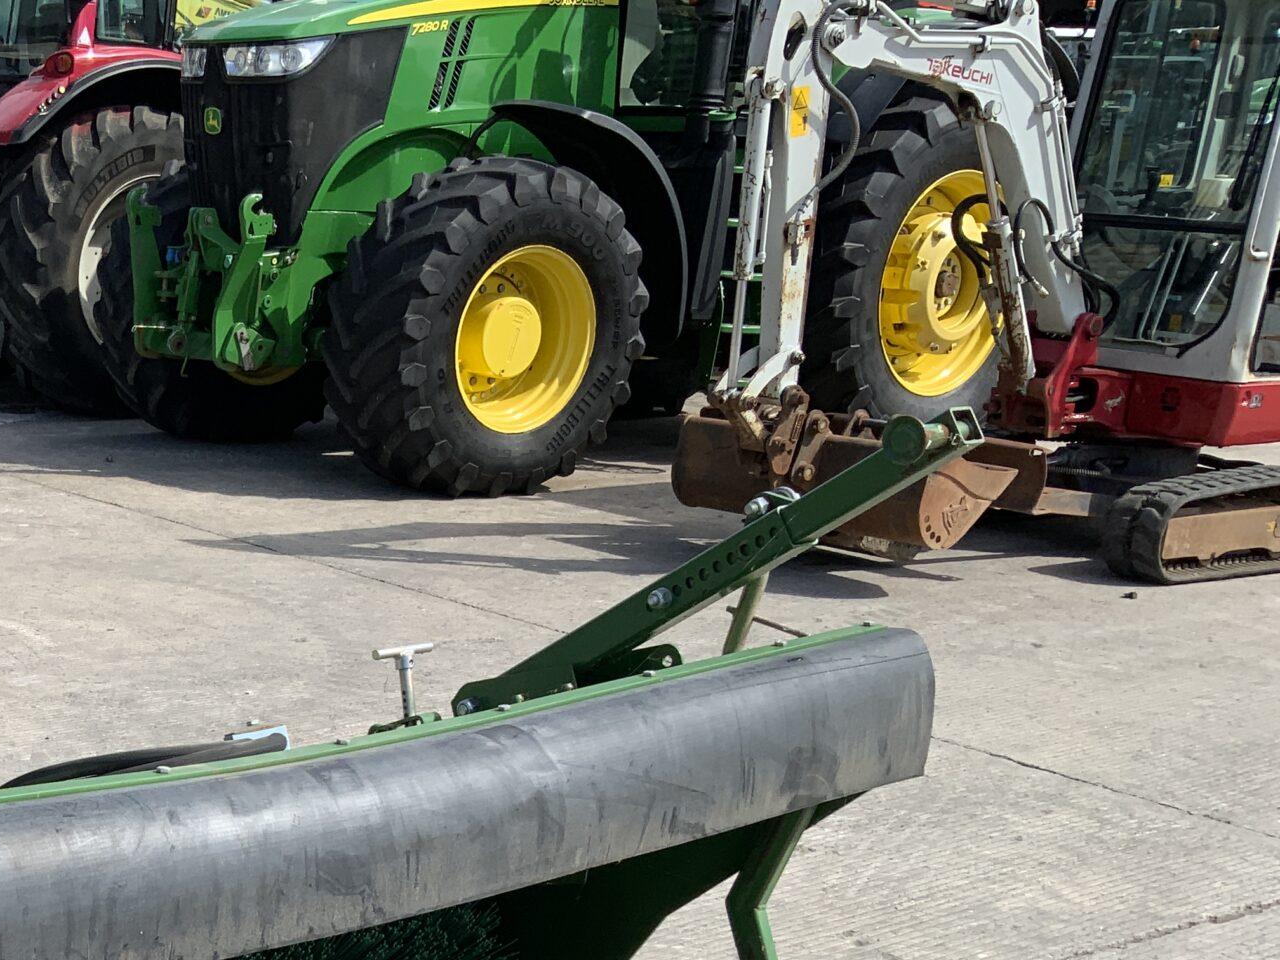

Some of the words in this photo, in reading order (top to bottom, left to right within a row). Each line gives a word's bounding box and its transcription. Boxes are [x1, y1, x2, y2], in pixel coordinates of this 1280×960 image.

[411, 20, 440, 36] 7280
[440, 19, 449, 31] R
[546, 362, 620, 455] TRELLEBORG
